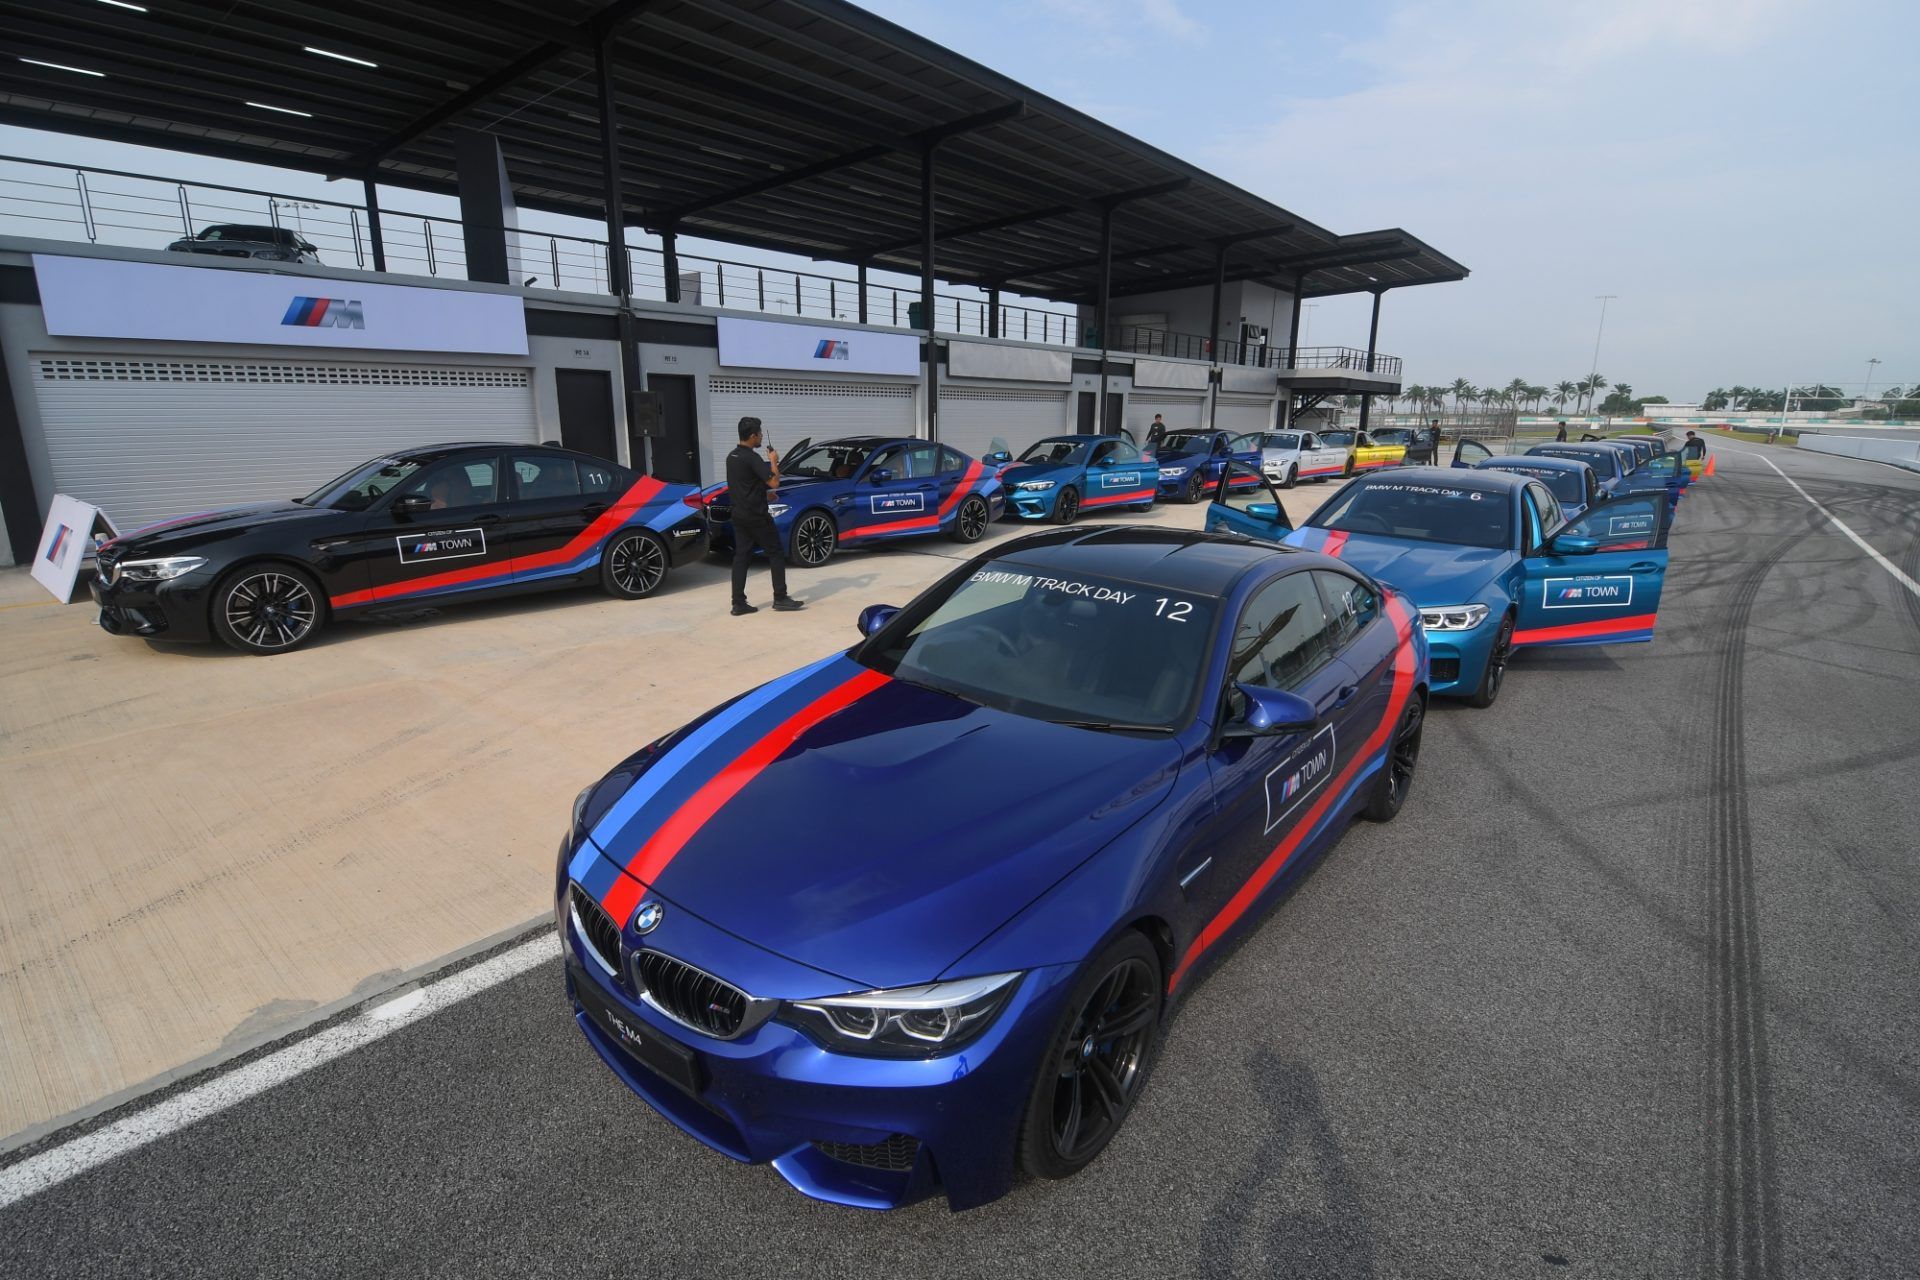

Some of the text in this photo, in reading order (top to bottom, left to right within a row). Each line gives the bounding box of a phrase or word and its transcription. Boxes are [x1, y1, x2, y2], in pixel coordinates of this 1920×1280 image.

[588, 473, 604, 485] 11
[1404, 485, 1441, 495] TRACK
[1441, 489, 1463, 497] DAY
[1470, 492, 1482, 501] 6
[895, 498, 916, 507] TOWN
[438, 538, 472, 550] TOWN
[970, 571, 1193, 622] BMW M TRACK DAY 12
[1585, 586, 1619, 597] TOWN
[1341, 591, 1357, 617] 12
[1300, 748, 1327, 784] TOWN
[605, 1009, 626, 1034] THE
[625, 1025, 642, 1046] M4
